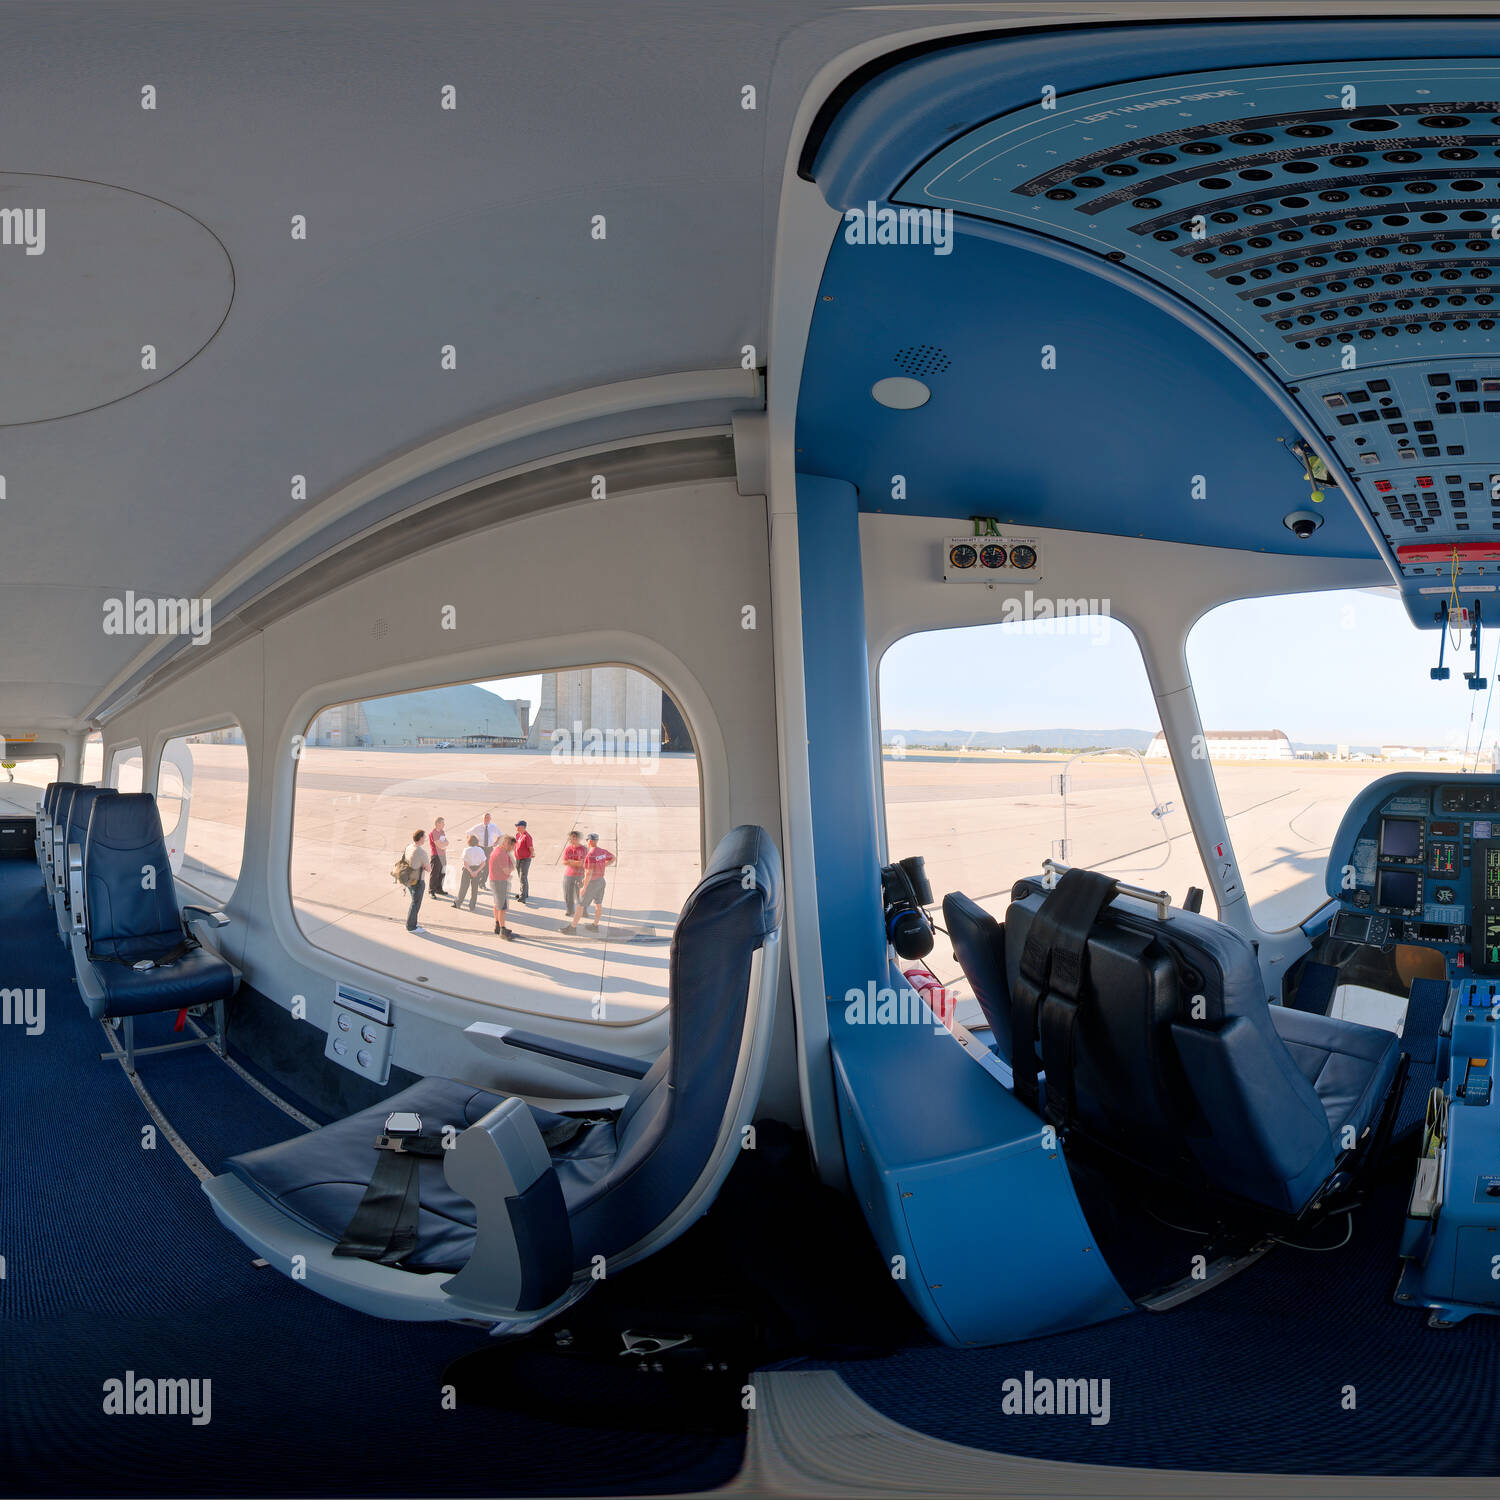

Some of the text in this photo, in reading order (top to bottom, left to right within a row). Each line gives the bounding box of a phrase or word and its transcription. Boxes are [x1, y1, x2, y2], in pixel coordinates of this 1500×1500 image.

[1074, 88, 1245, 125] LEFT HAND SIDE
